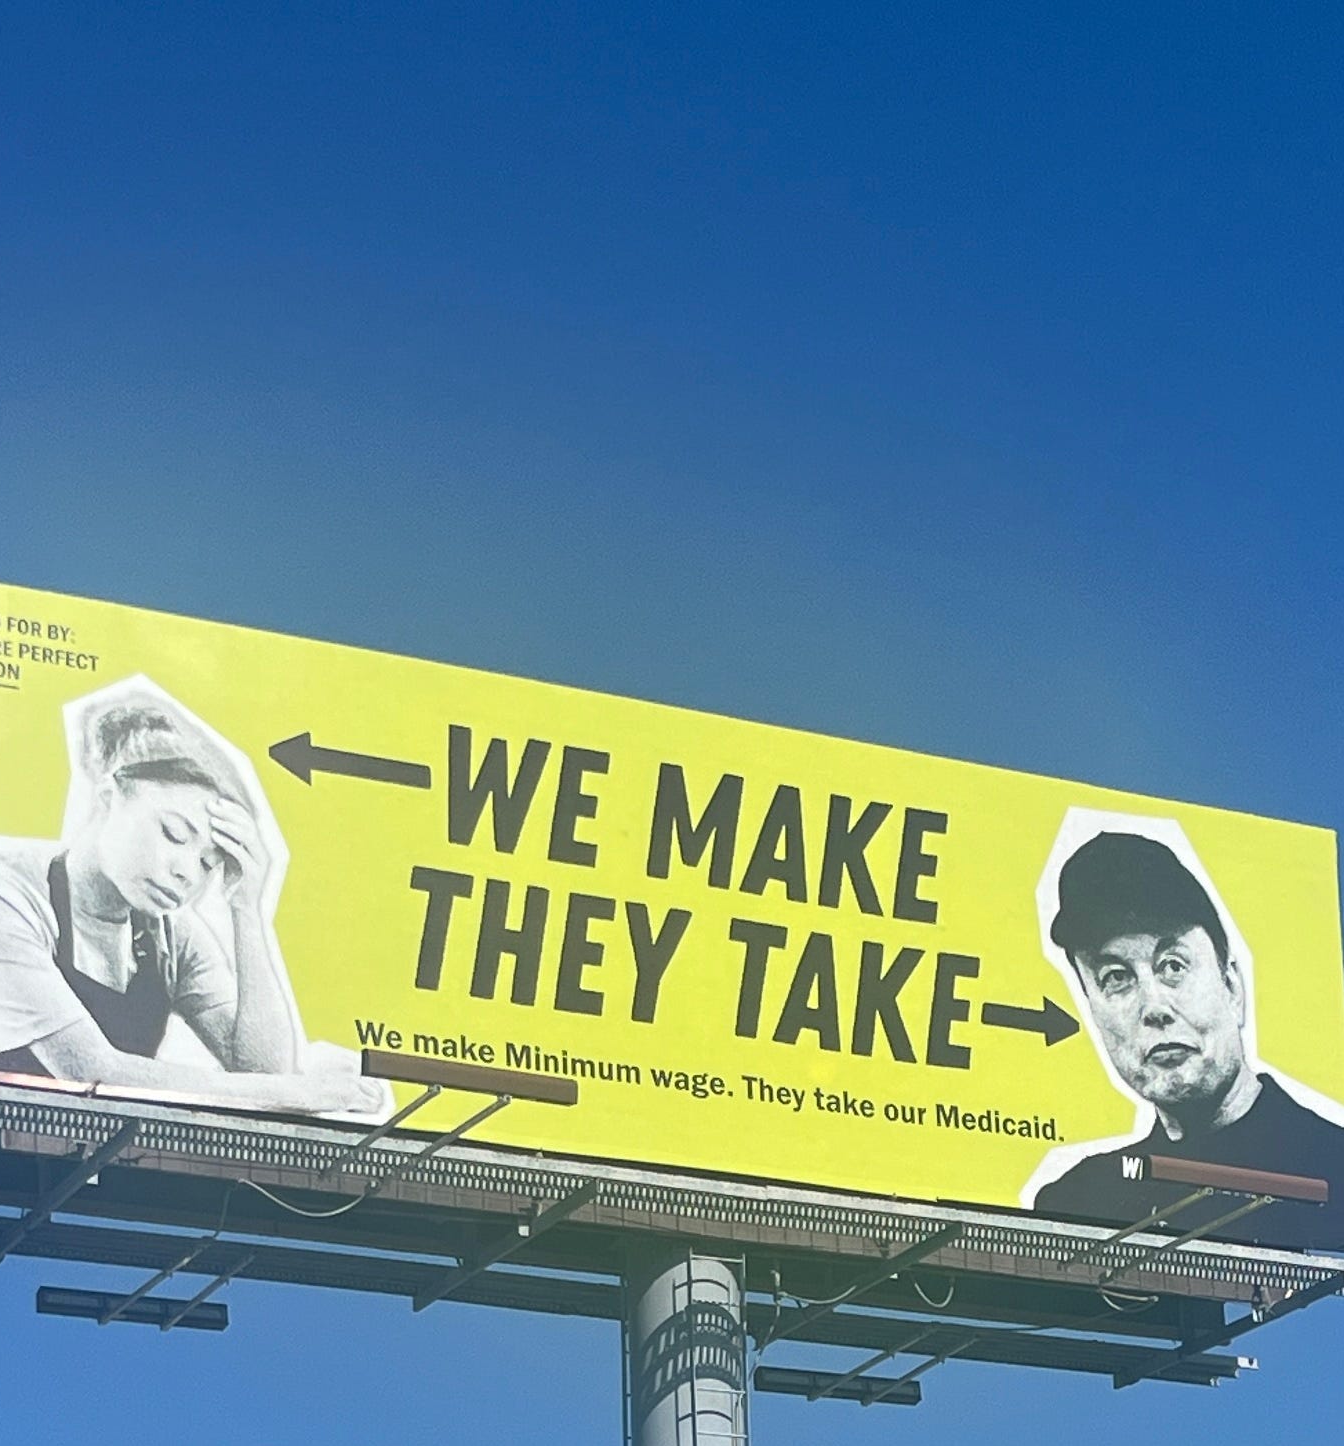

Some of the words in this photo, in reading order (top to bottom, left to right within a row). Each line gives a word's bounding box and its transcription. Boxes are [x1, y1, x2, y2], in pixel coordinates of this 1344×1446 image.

[7, 616, 42, 638] FOR
[47, 624, 76, 644] BY:
[18, 642, 99, 672] PERFECT
[448, 724, 610, 868] WE
[646, 763, 948, 924] MAKE
[410, 865, 692, 1024] THEY
[729, 918, 980, 1070] TAKE
[355, 1018, 403, 1050] We
[412, 1029, 495, 1064] make
[505, 1042, 641, 1086] Minimum
[650, 1065, 734, 1100] wage.
[742, 1076, 805, 1113] They
[814, 1088, 876, 1119] take
[883, 1102, 927, 1126] our
[935, 1105, 1065, 1142] Medicaid.
